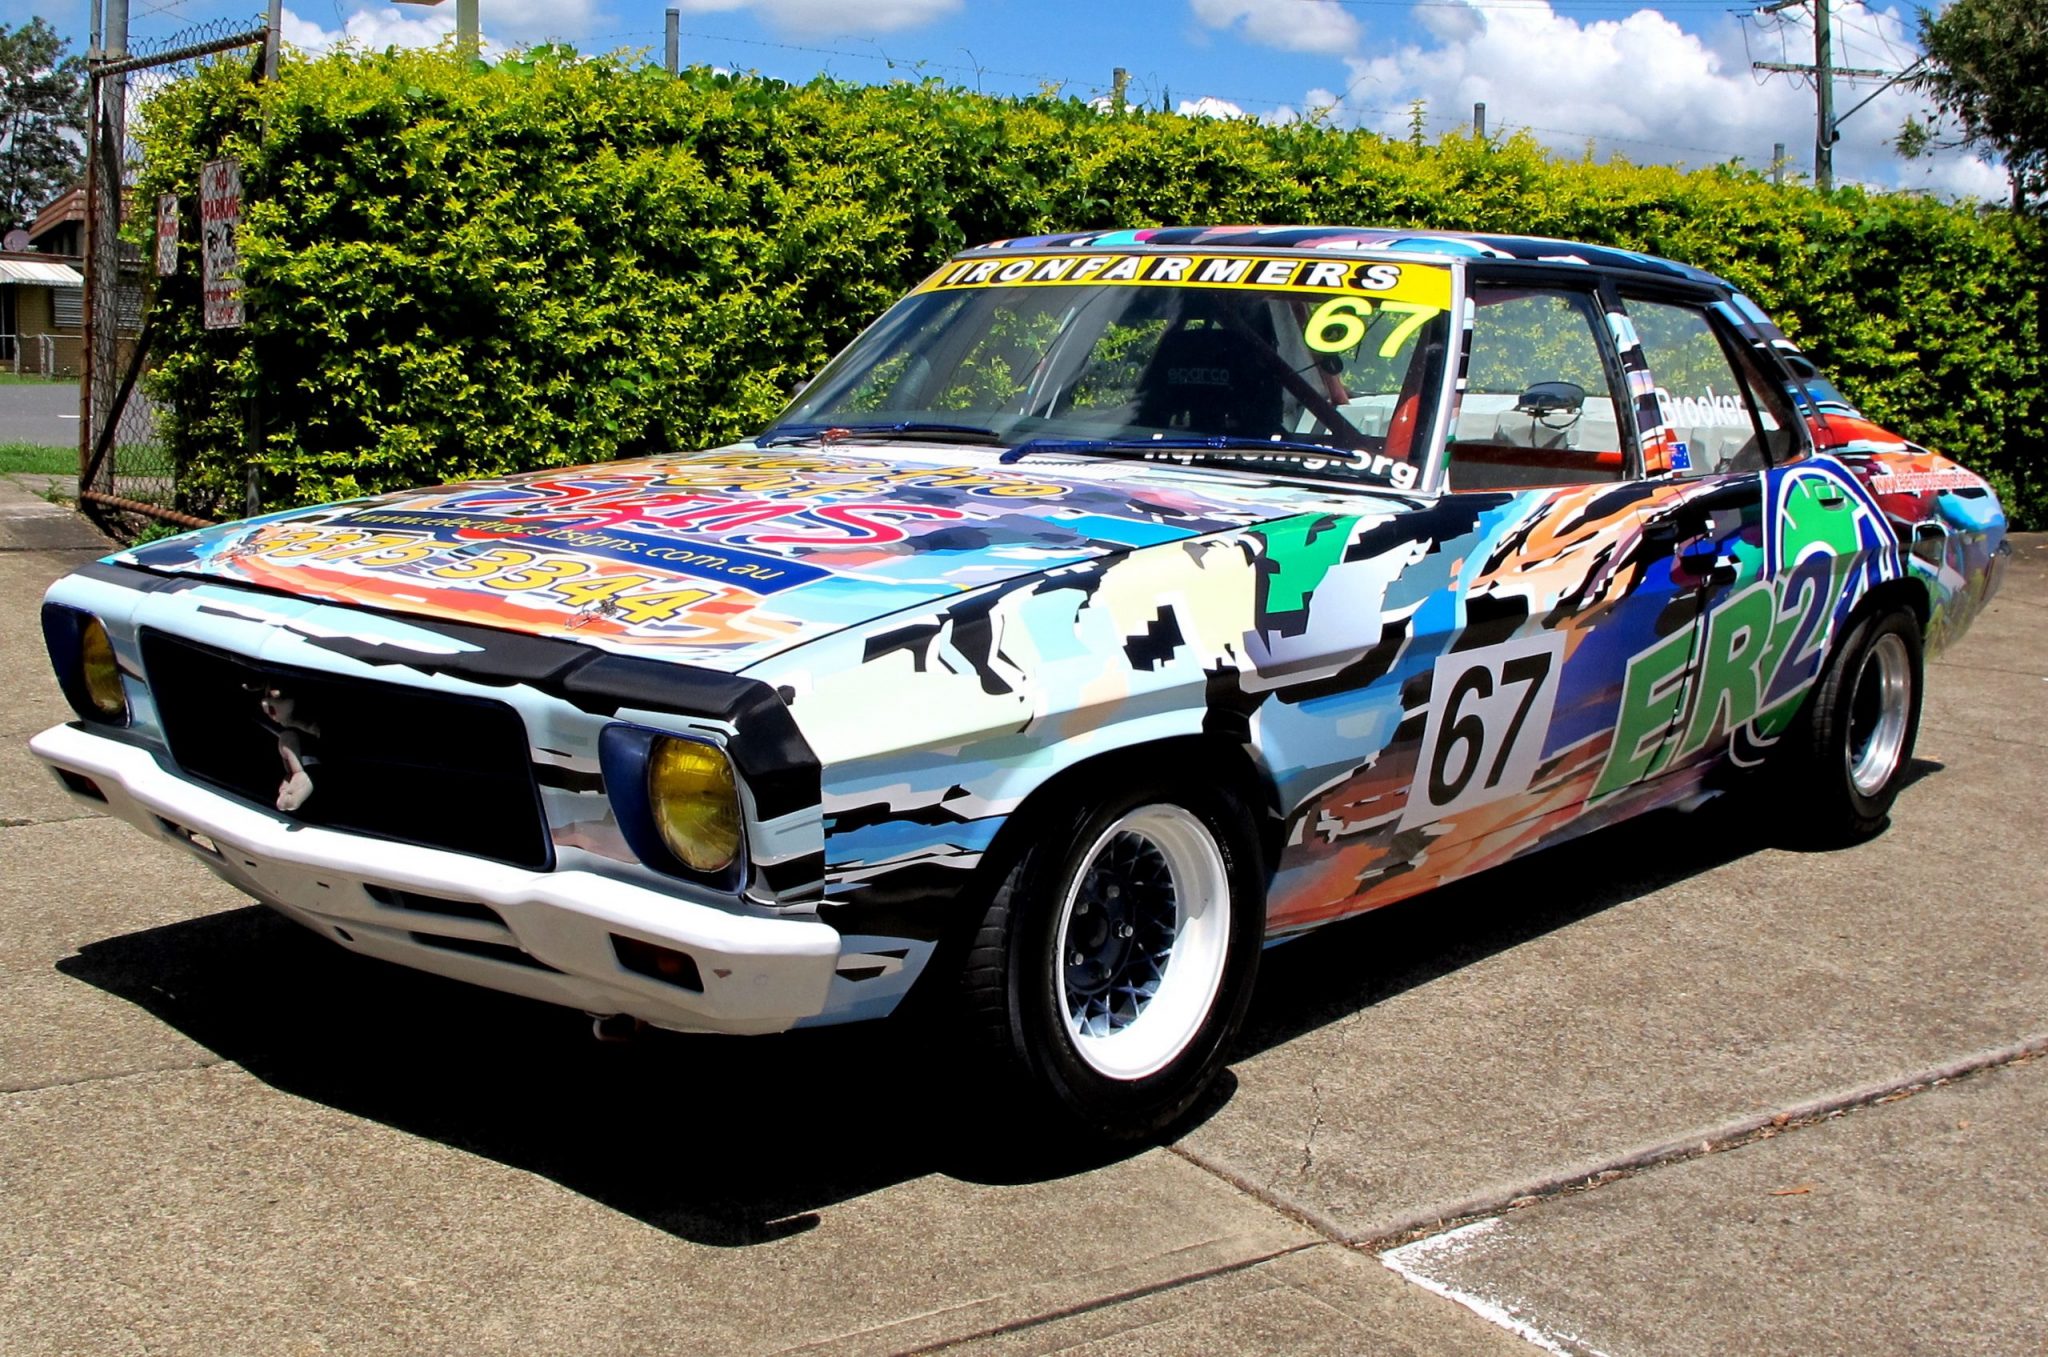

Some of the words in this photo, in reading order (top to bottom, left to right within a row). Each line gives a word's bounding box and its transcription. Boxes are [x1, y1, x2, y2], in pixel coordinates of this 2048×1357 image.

[215, 168, 228, 191] NO
[945, 255, 1403, 291] IRONFARMERS
[1303, 297, 1441, 358] 67
[255, 530, 460, 566] 3375
[428, 546, 716, 624] 3344
[1428, 652, 1553, 807] 67
